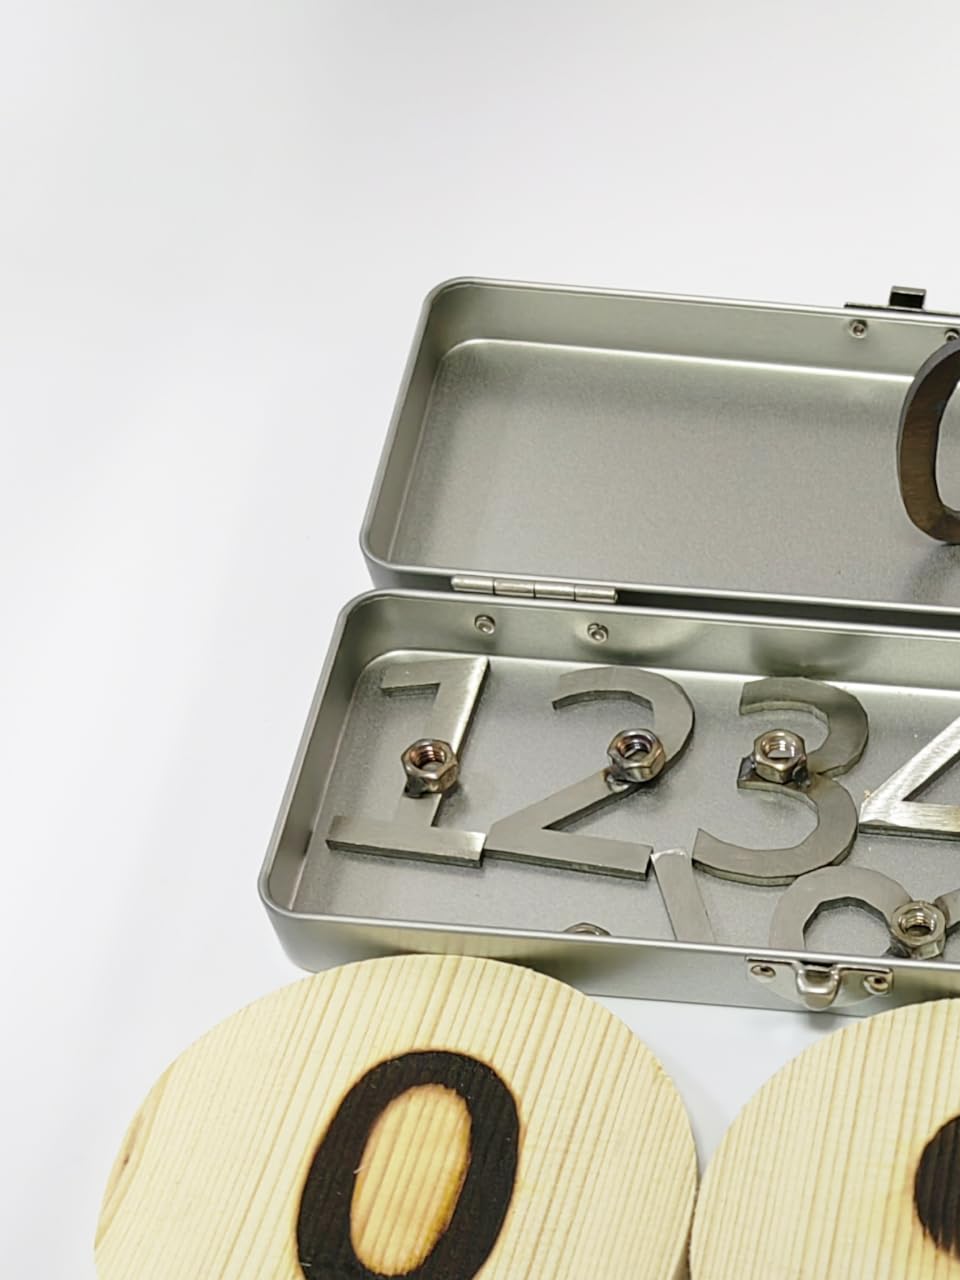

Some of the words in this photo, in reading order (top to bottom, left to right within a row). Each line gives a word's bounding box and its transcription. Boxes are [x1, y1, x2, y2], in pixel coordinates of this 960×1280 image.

[326, 655, 490, 868] 1
[482, 666, 695, 881] 2
[692, 676, 868, 888] 3
